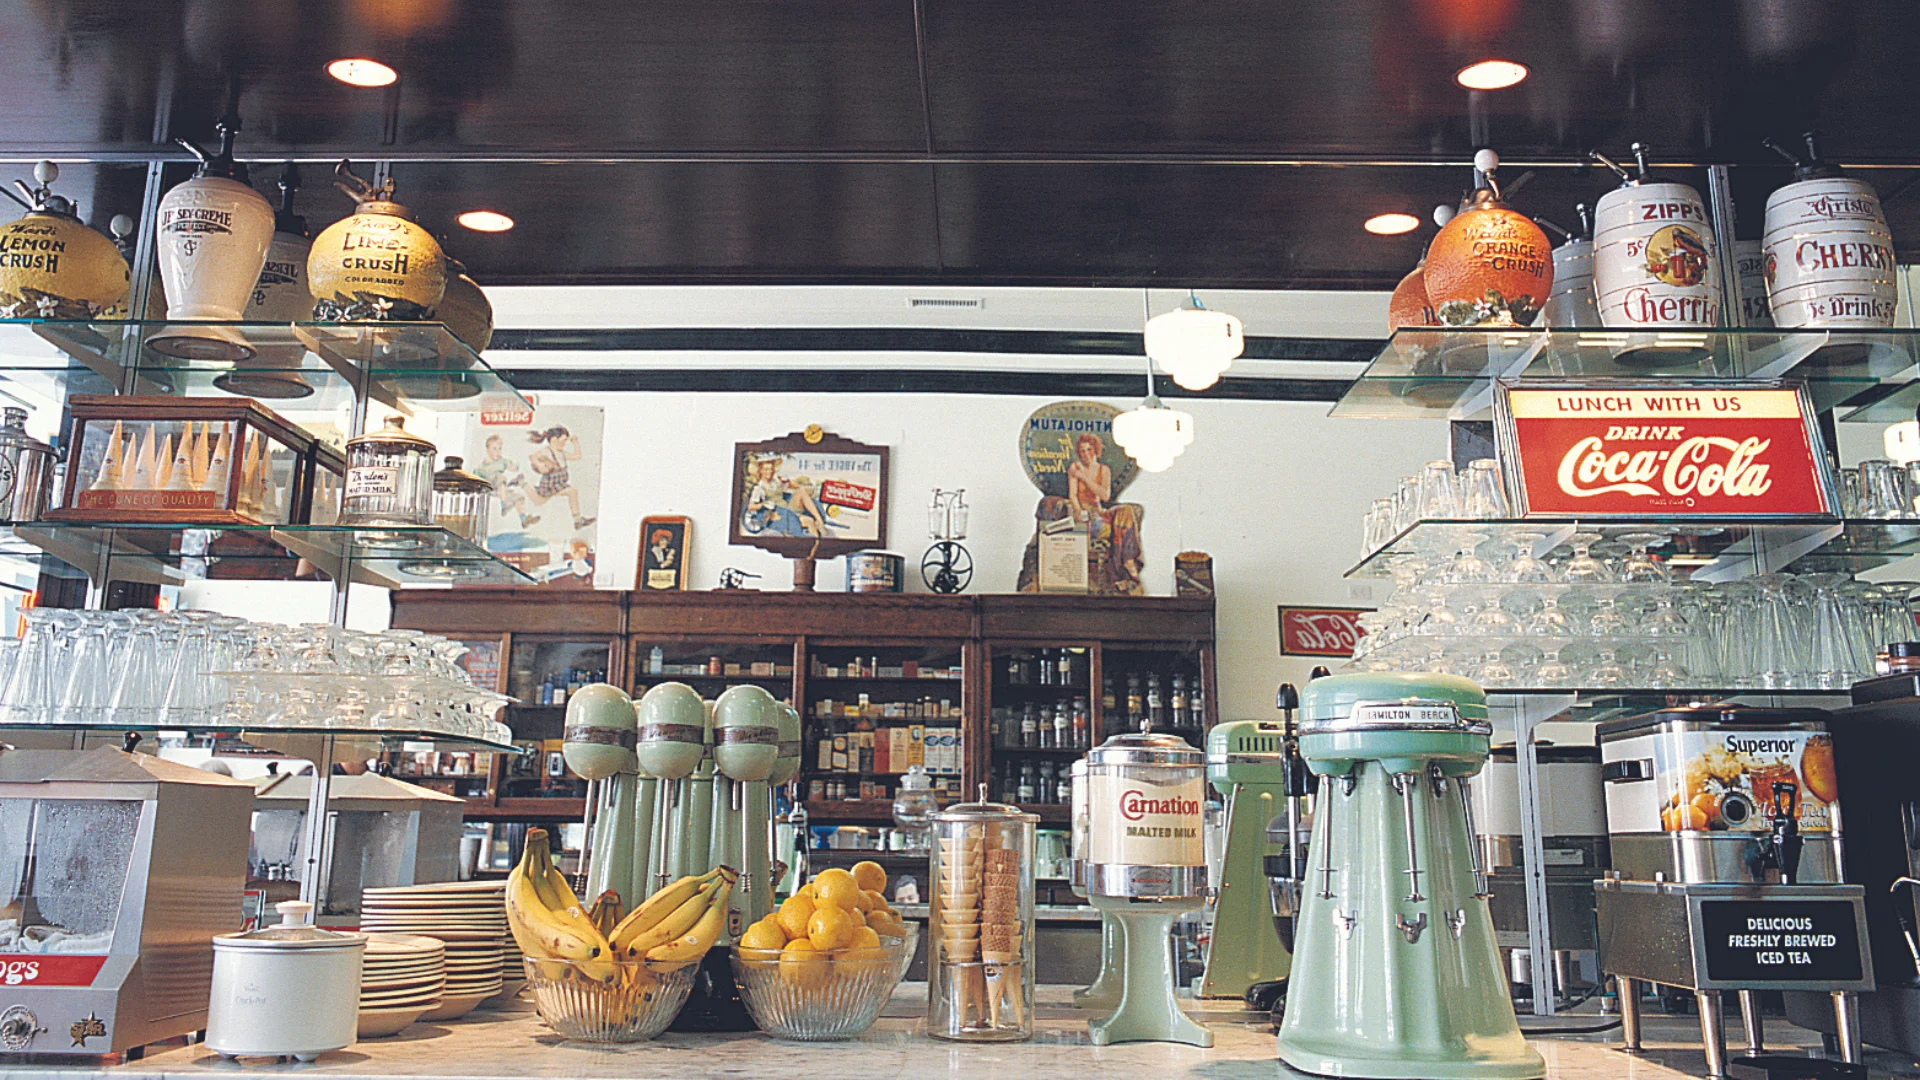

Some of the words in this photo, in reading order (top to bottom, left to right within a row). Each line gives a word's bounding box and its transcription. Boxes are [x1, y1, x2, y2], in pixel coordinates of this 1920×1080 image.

[162, 208, 233, 227] JESEY-CREME
[0, 235, 66, 253] LEMON
[0, 253, 59, 273] CRUSH
[342, 253, 409, 275] CRUSH
[1796, 240, 1894, 273] CHERRY
[1491, 256, 1545, 279] CRUSH
[1828, 297, 1883, 318] Drink
[1557, 397, 1633, 413] LUNCH
[1644, 397, 1701, 413] WITH
[1712, 397, 1742, 412] US
[1604, 426, 1686, 441] DRINK
[1557, 436, 1772, 497] Coca-Cola
[84, 494, 104, 505] THE
[108, 494, 140, 505] CONE
[161, 494, 211, 506] QUALITY
[1420, 709, 1450, 720] BEACH
[1726, 734, 1796, 756] Superior
[1119, 789, 1199, 821] Carnation
[1126, 825, 1173, 838] MALTED
[1173, 827, 1197, 838] MILK
[1747, 917, 1813, 931] DELICIOUS
[1728, 934, 1781, 947] FRESHLY
[1784, 934, 1837, 947] BREWED
[1756, 951, 1785, 965] ICED
[1787, 951, 1812, 964] TEA
